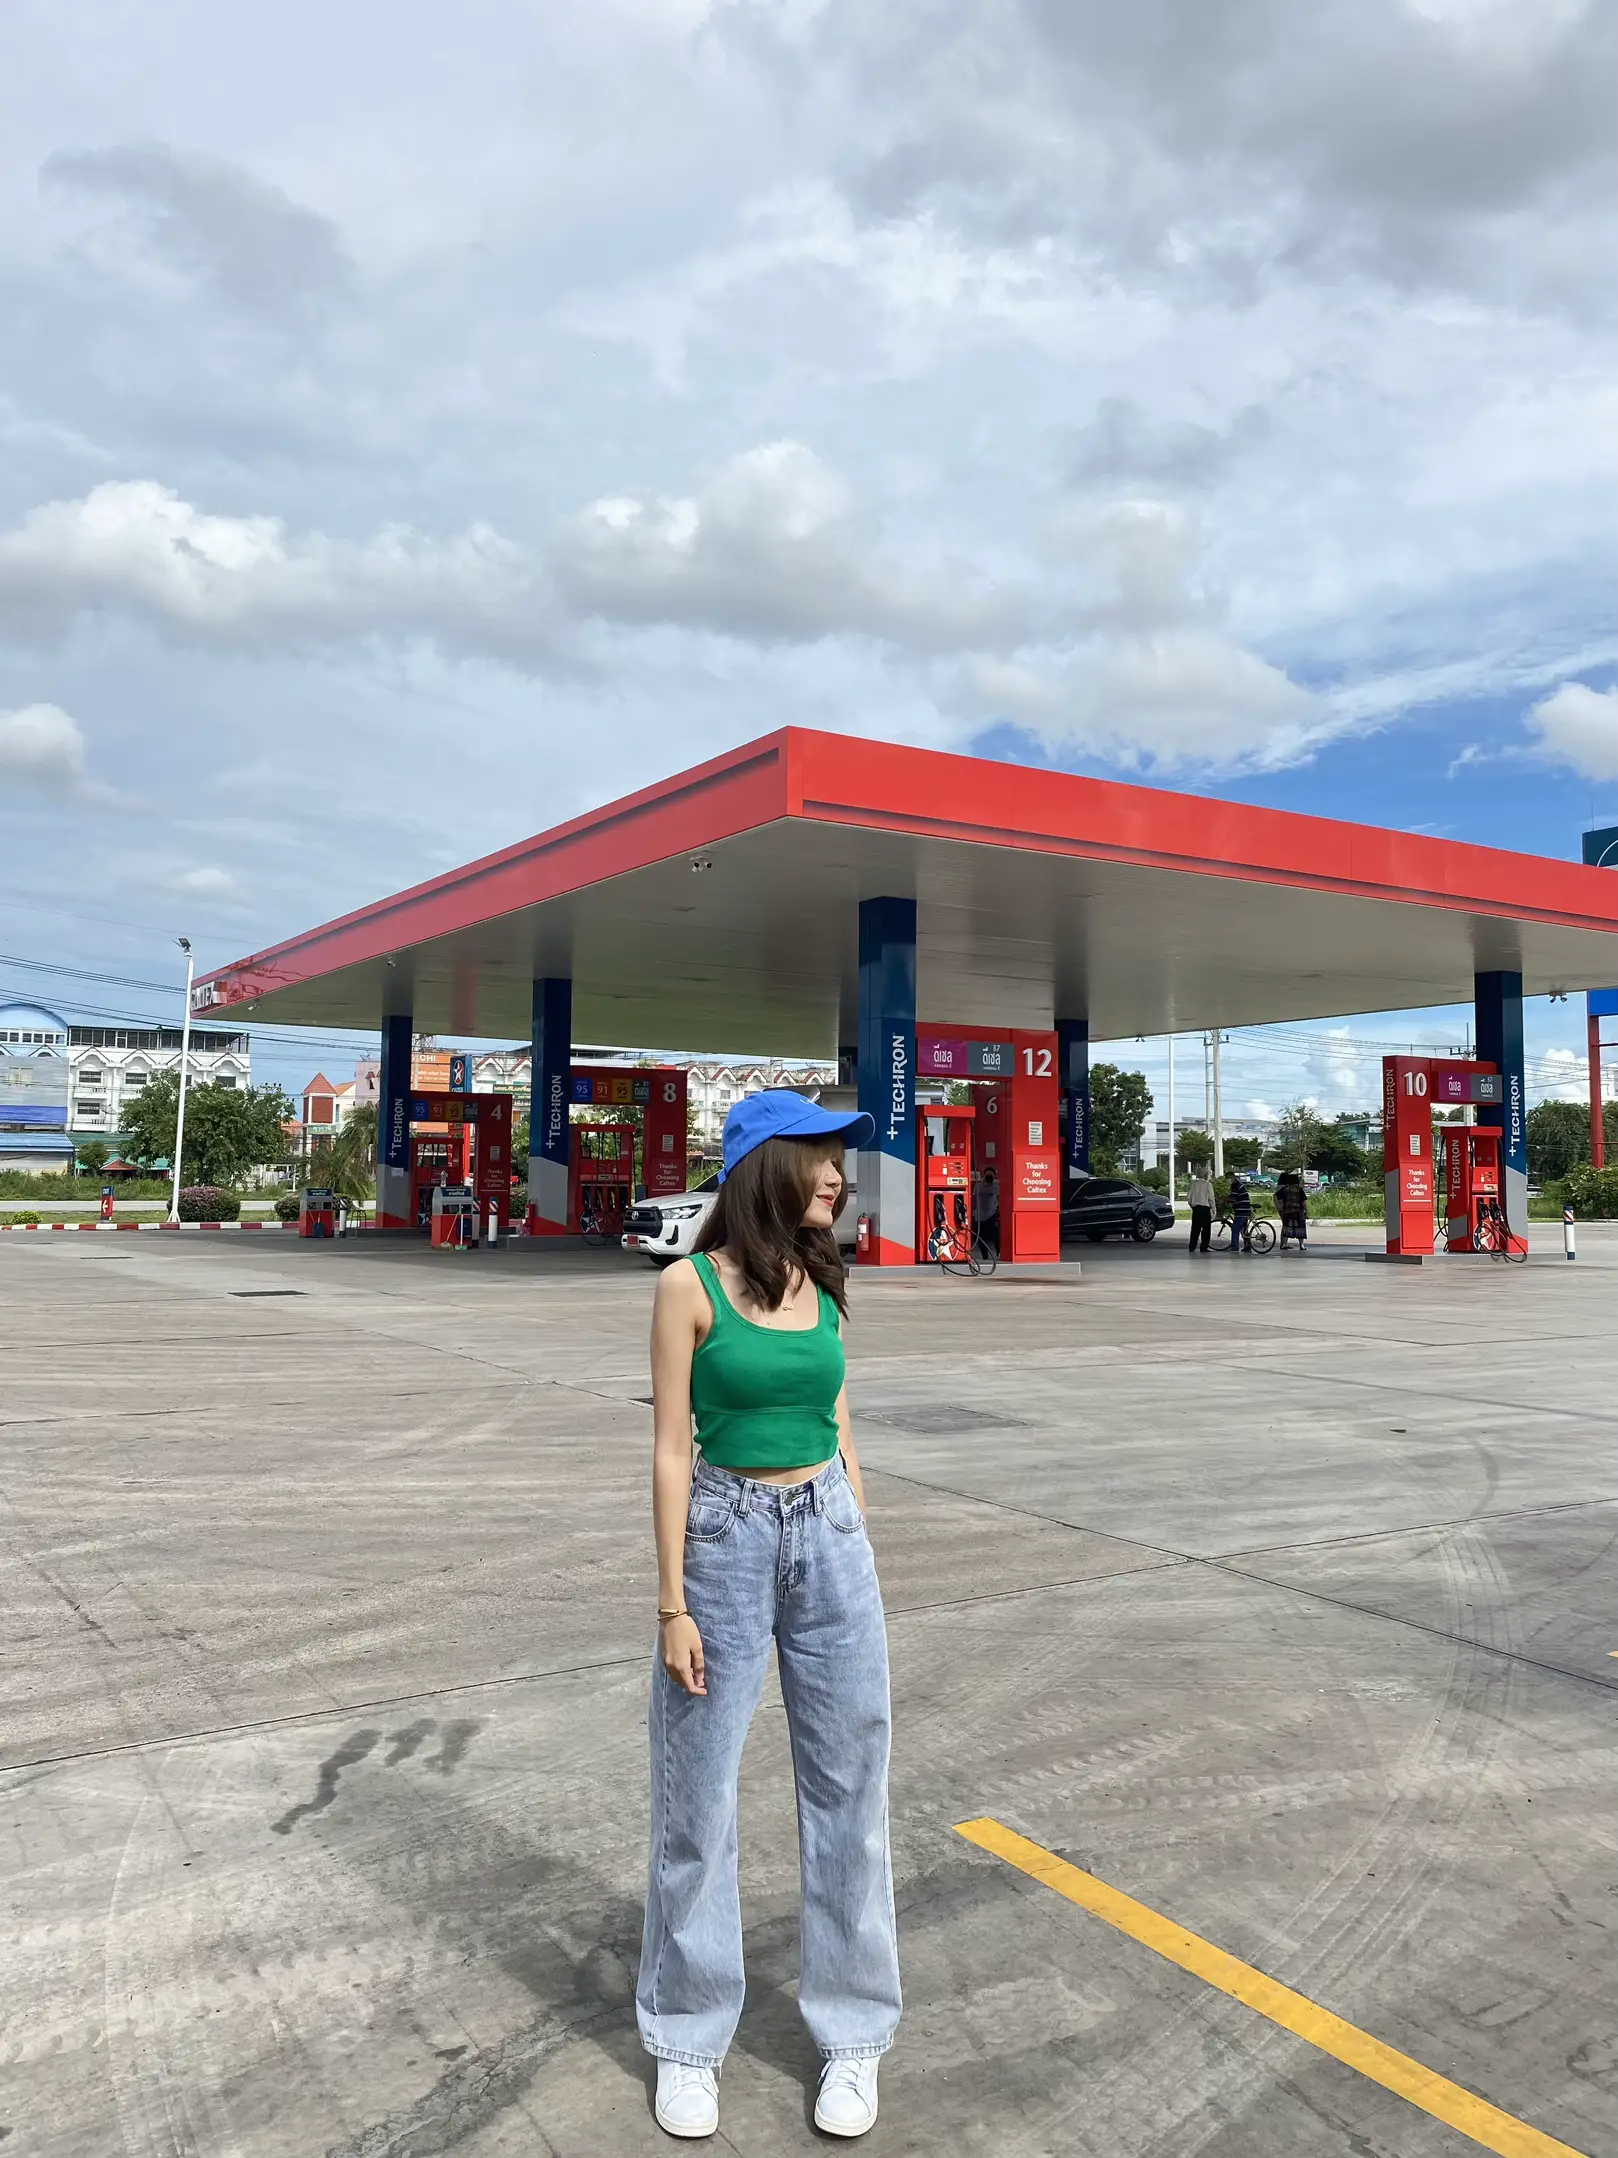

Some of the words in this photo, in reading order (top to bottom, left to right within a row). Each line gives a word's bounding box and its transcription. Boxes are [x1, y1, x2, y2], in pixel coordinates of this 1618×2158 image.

[1022, 1048, 1052, 1077] 12
[1404, 1071, 1428, 1096] 10
[576, 1085, 588, 1094] 95
[597, 1086, 608, 1095] 91
[663, 1083, 677, 1103] 8
[986, 1097, 998, 1114] 6
[490, 1104, 502, 1120] 4
[1025, 1162, 1048, 1170] Thanks
[1032, 1170, 1041, 1178] for
[1022, 1178, 1052, 1187] Choosing
[1027, 1186, 1047, 1194] Caltex
